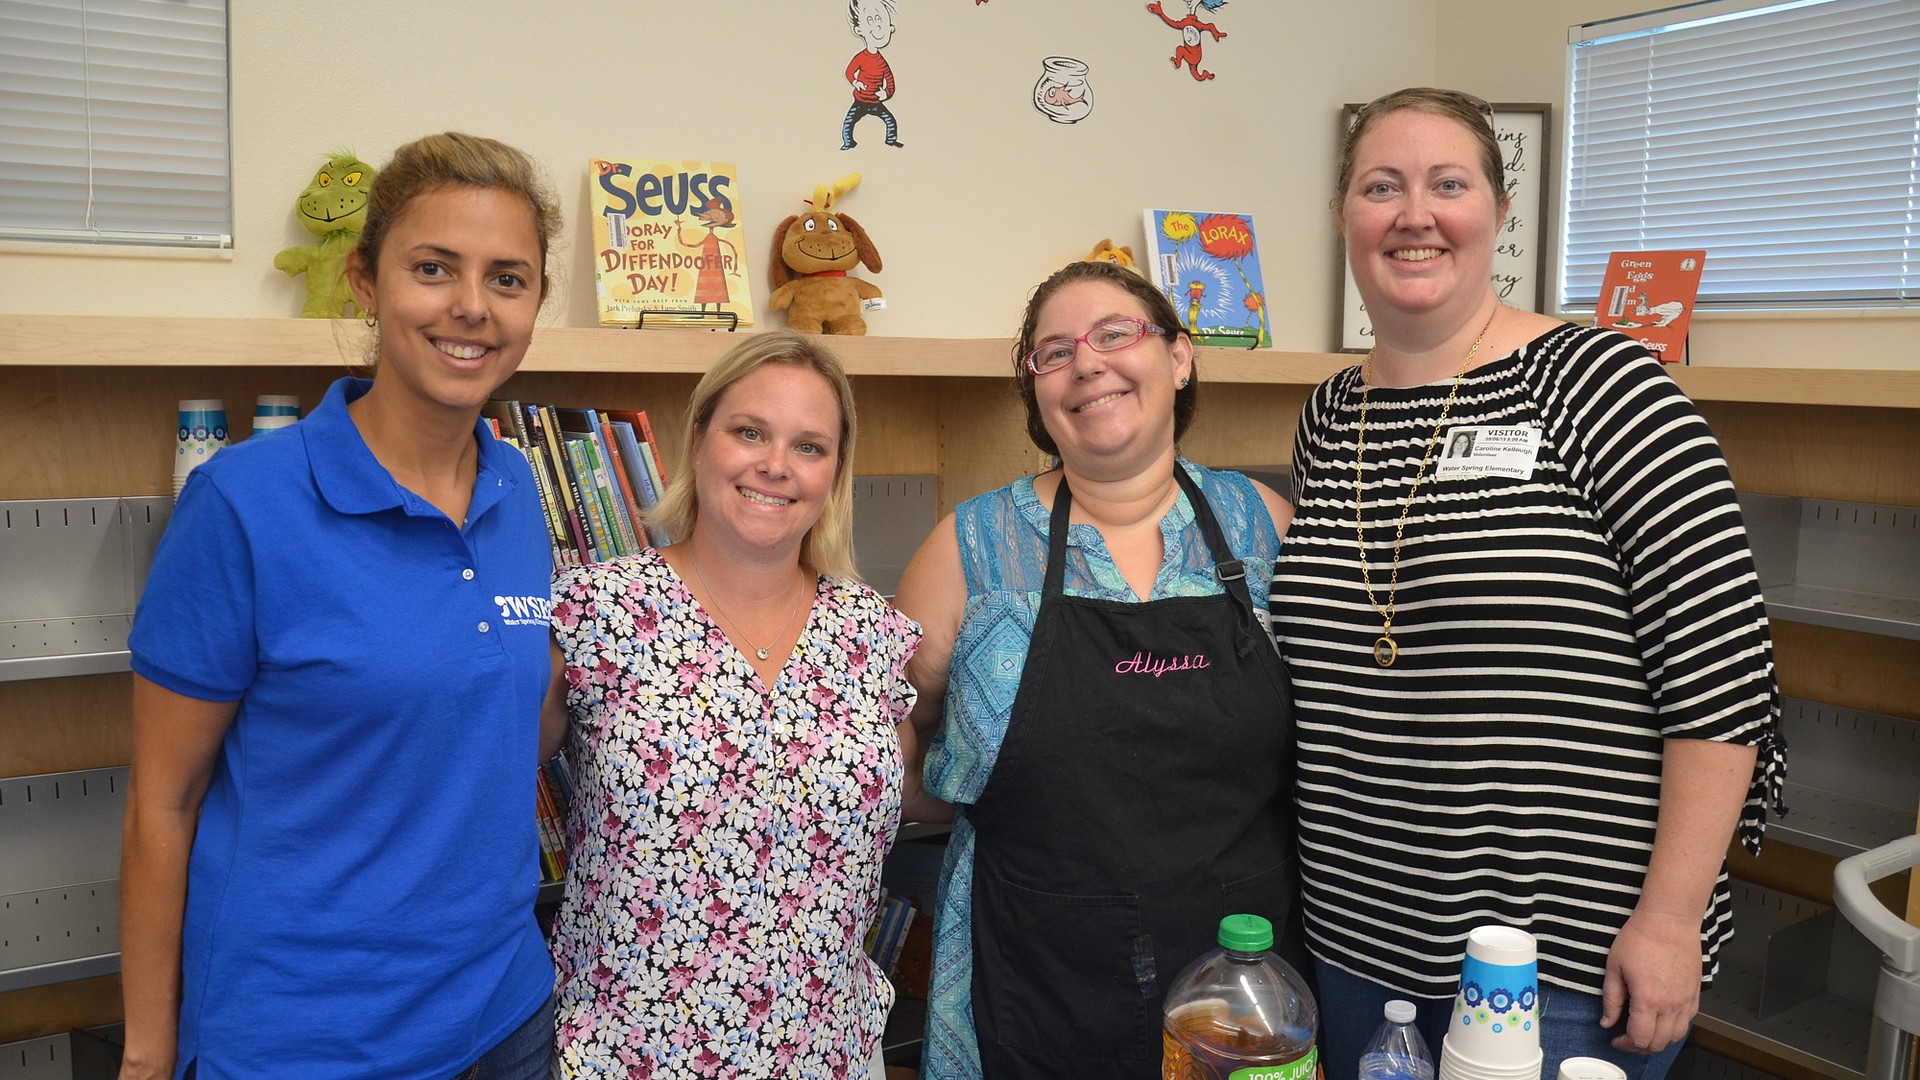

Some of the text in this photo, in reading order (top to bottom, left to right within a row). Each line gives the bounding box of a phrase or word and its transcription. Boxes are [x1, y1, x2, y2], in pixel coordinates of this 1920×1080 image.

[1496, 128, 1527, 148] ins
[594, 160, 623, 176] Dr.
[599, 163, 733, 220] Seuss
[608, 222, 672, 239] ORAY
[1170, 221, 1249, 245] The LORAX
[631, 239, 655, 251] FOR
[600, 249, 733, 273] DIFFENDOOFER
[1621, 259, 1652, 269] Green
[627, 273, 678, 295] DAY!
[1626, 271, 1654, 282] Eggs
[1639, 338, 1668, 352] Seuss
[1488, 429, 1529, 437] VISITOR
[1461, 465, 1484, 474] Spring
[1485, 465, 1525, 475] Elementary
[571, 486, 581, 503] WILL
[577, 504, 585, 517] NOT
[581, 518, 589, 531] EAT
[1115, 651, 1210, 678] Alyssa
